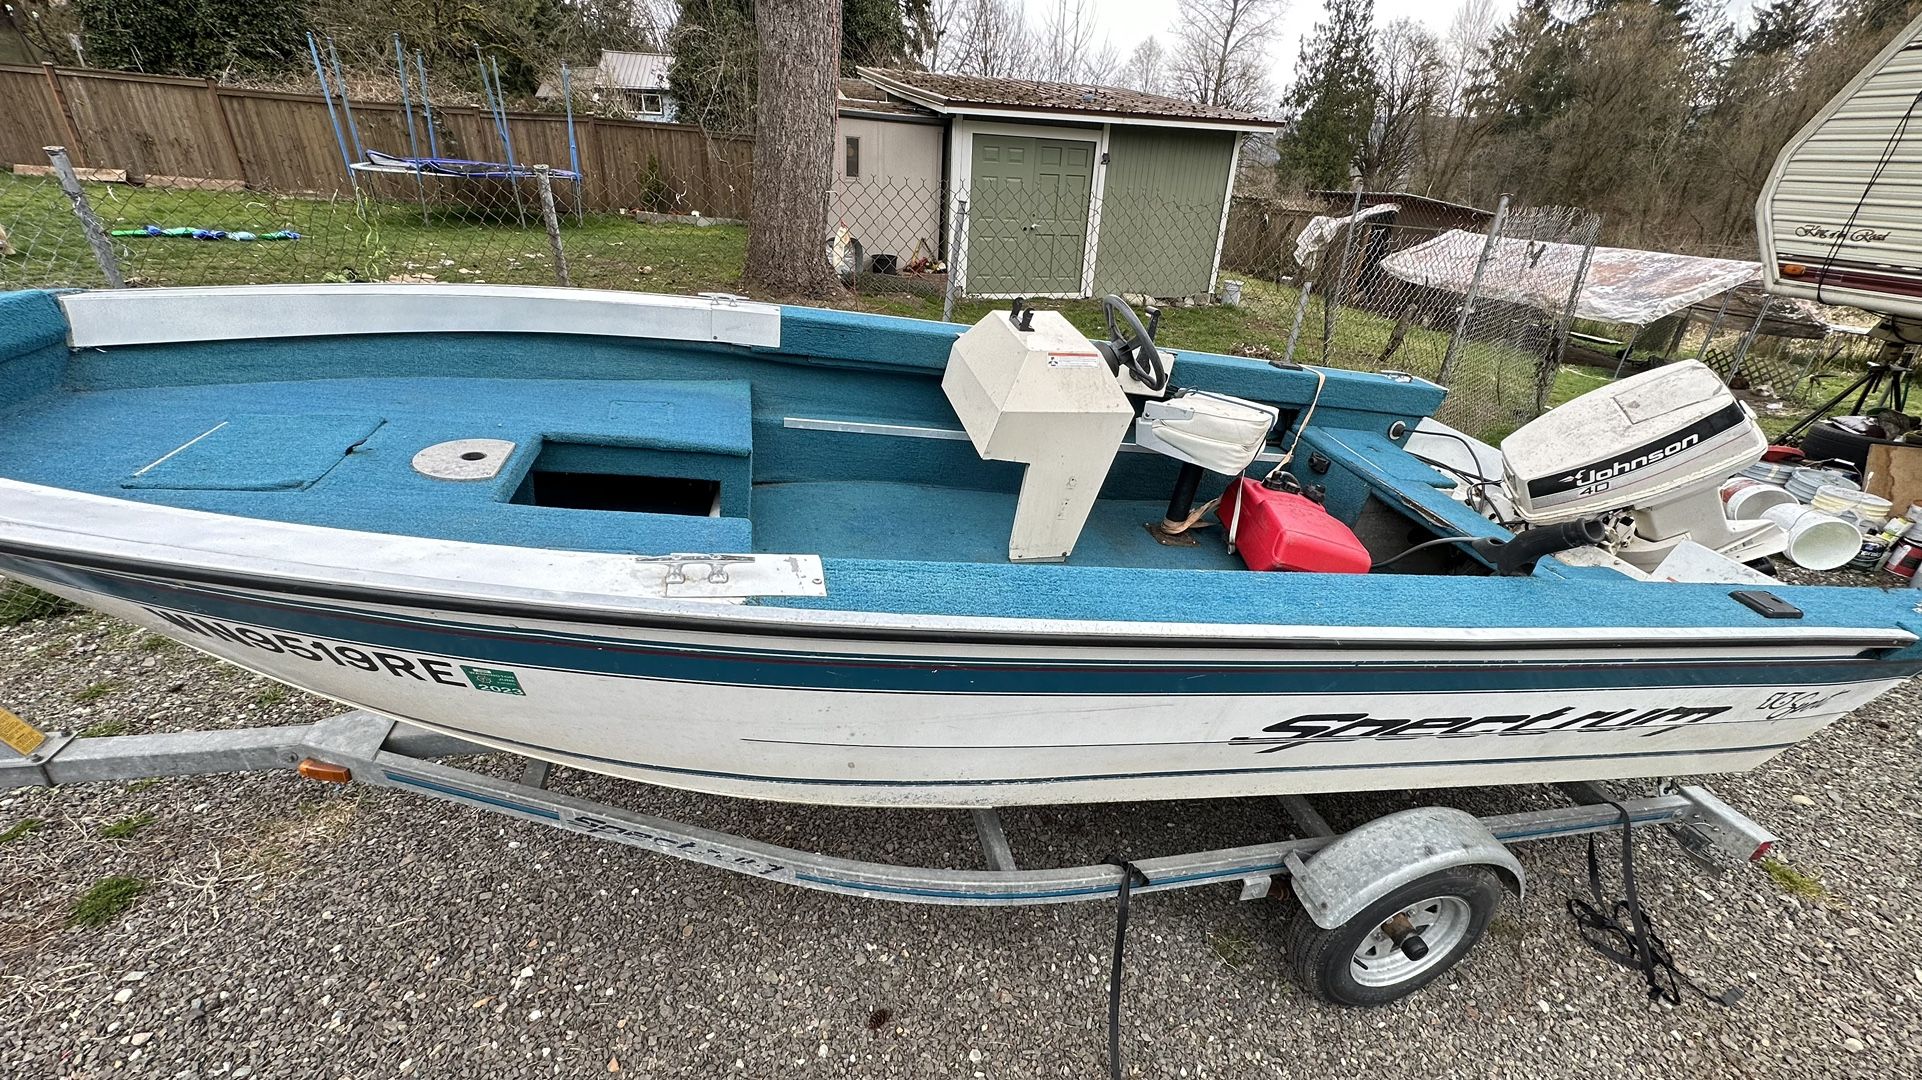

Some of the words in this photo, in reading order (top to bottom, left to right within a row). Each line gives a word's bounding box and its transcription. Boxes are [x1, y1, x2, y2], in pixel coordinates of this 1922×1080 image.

[1795, 224, 1830, 239] King
[1576, 432, 1699, 487] Johnson
[1579, 481, 1610, 497] 40
[478, 683, 524, 696] 2023
[1228, 705, 1734, 754] Spectrum
